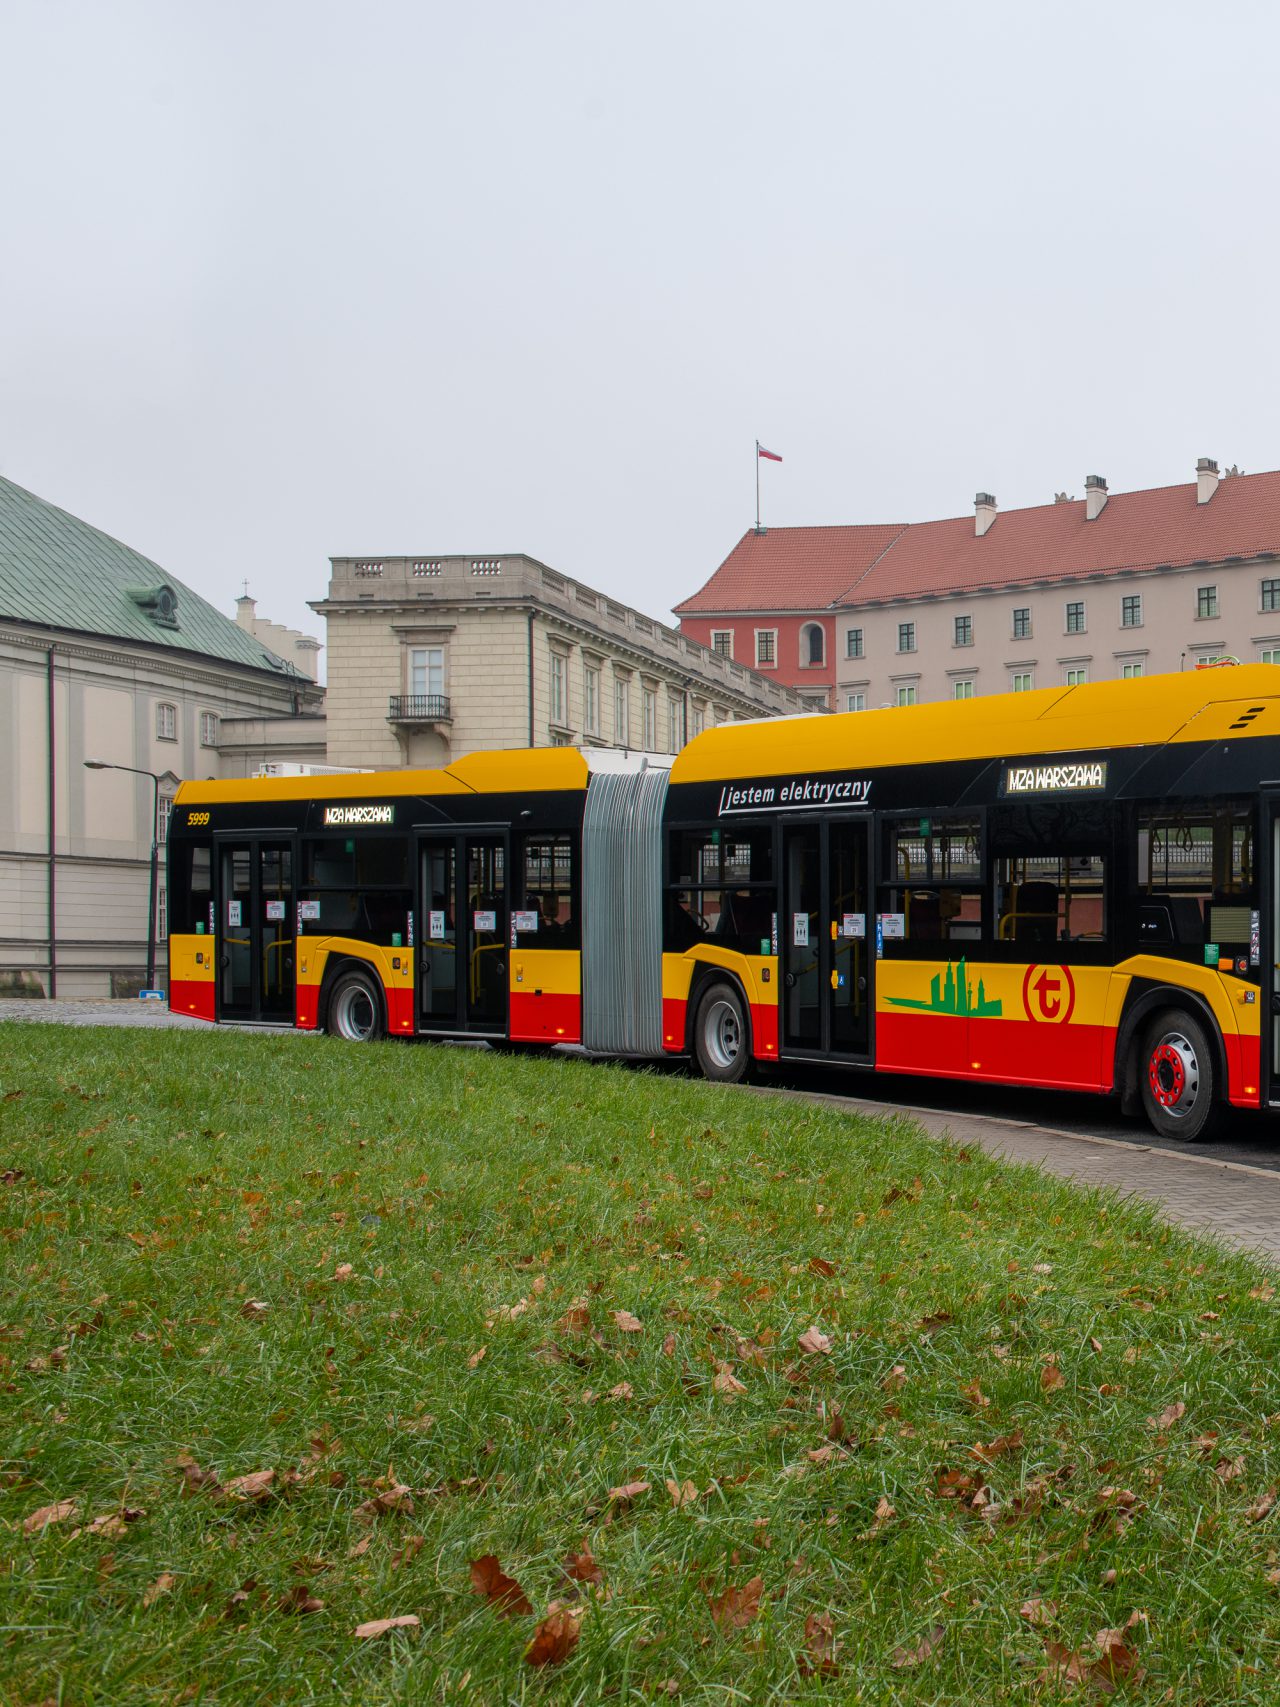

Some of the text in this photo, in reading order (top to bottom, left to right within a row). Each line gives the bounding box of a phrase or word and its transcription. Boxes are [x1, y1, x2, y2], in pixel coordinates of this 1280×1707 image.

[1009, 764, 1102, 790] MZA WARSZAWA
[725, 780, 873, 810] jestem elektryczny
[187, 812, 210, 826] 5999
[325, 806, 392, 823] MZA WARSZAWA
